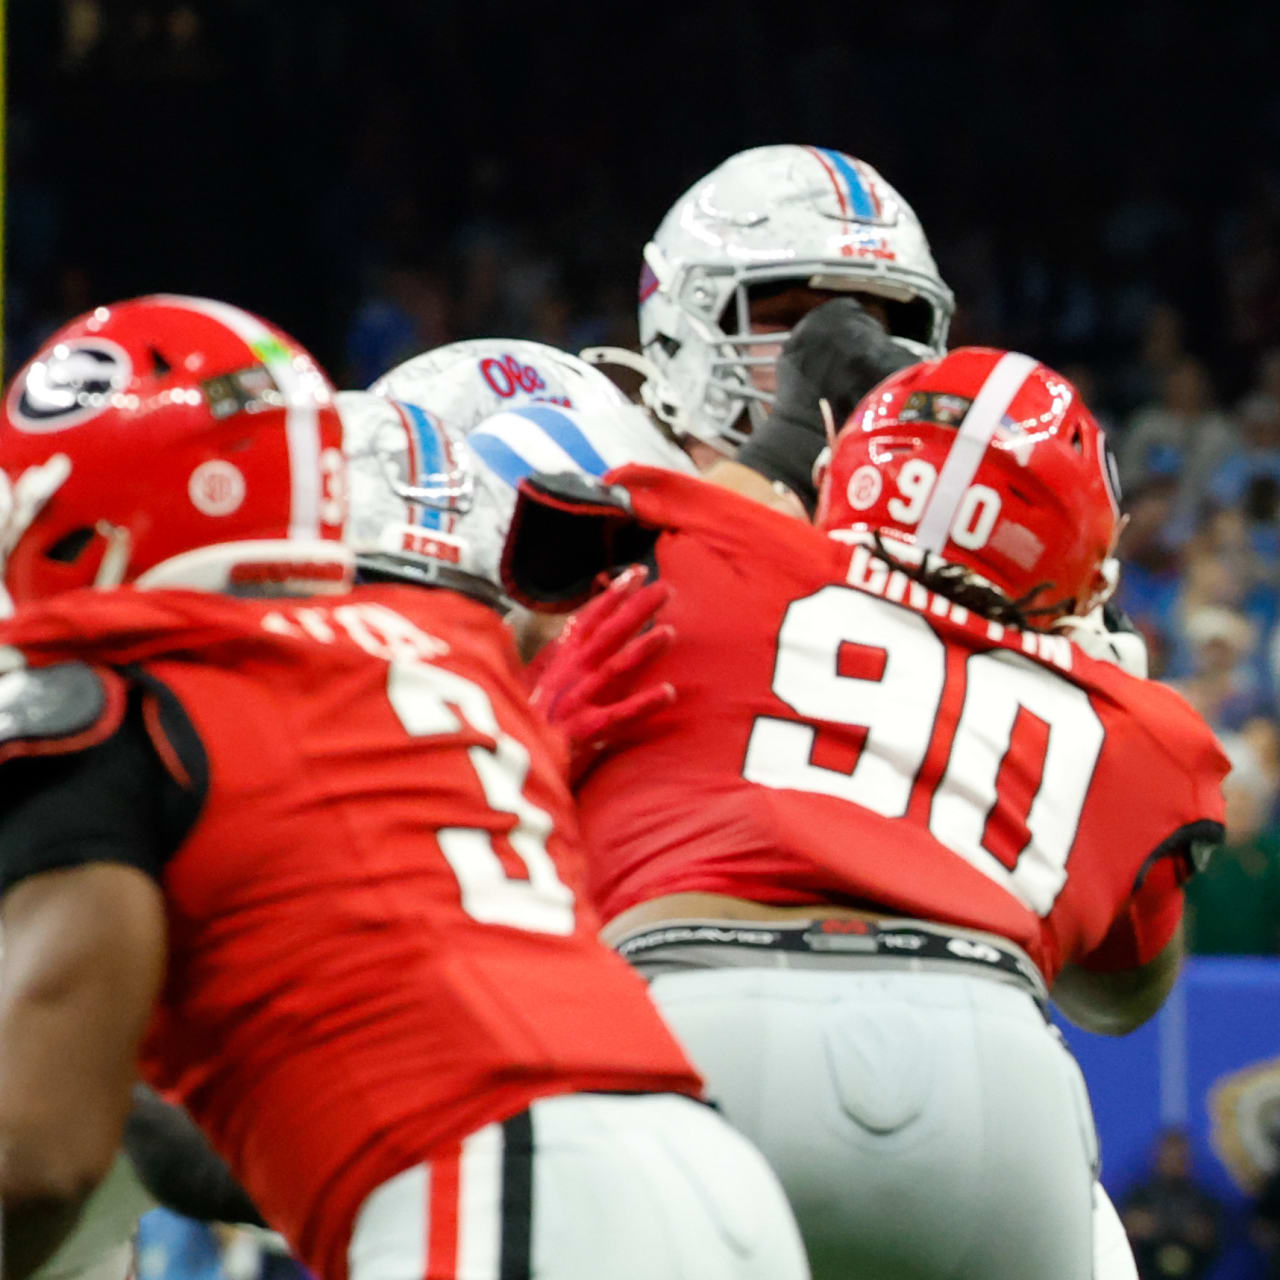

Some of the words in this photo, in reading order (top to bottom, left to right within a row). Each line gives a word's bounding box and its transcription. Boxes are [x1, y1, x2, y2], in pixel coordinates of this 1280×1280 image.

[479, 354, 546, 399] Ole
[887, 458, 1001, 550] 90
[387, 656, 576, 937] 3
[742, 584, 1106, 919] 90
